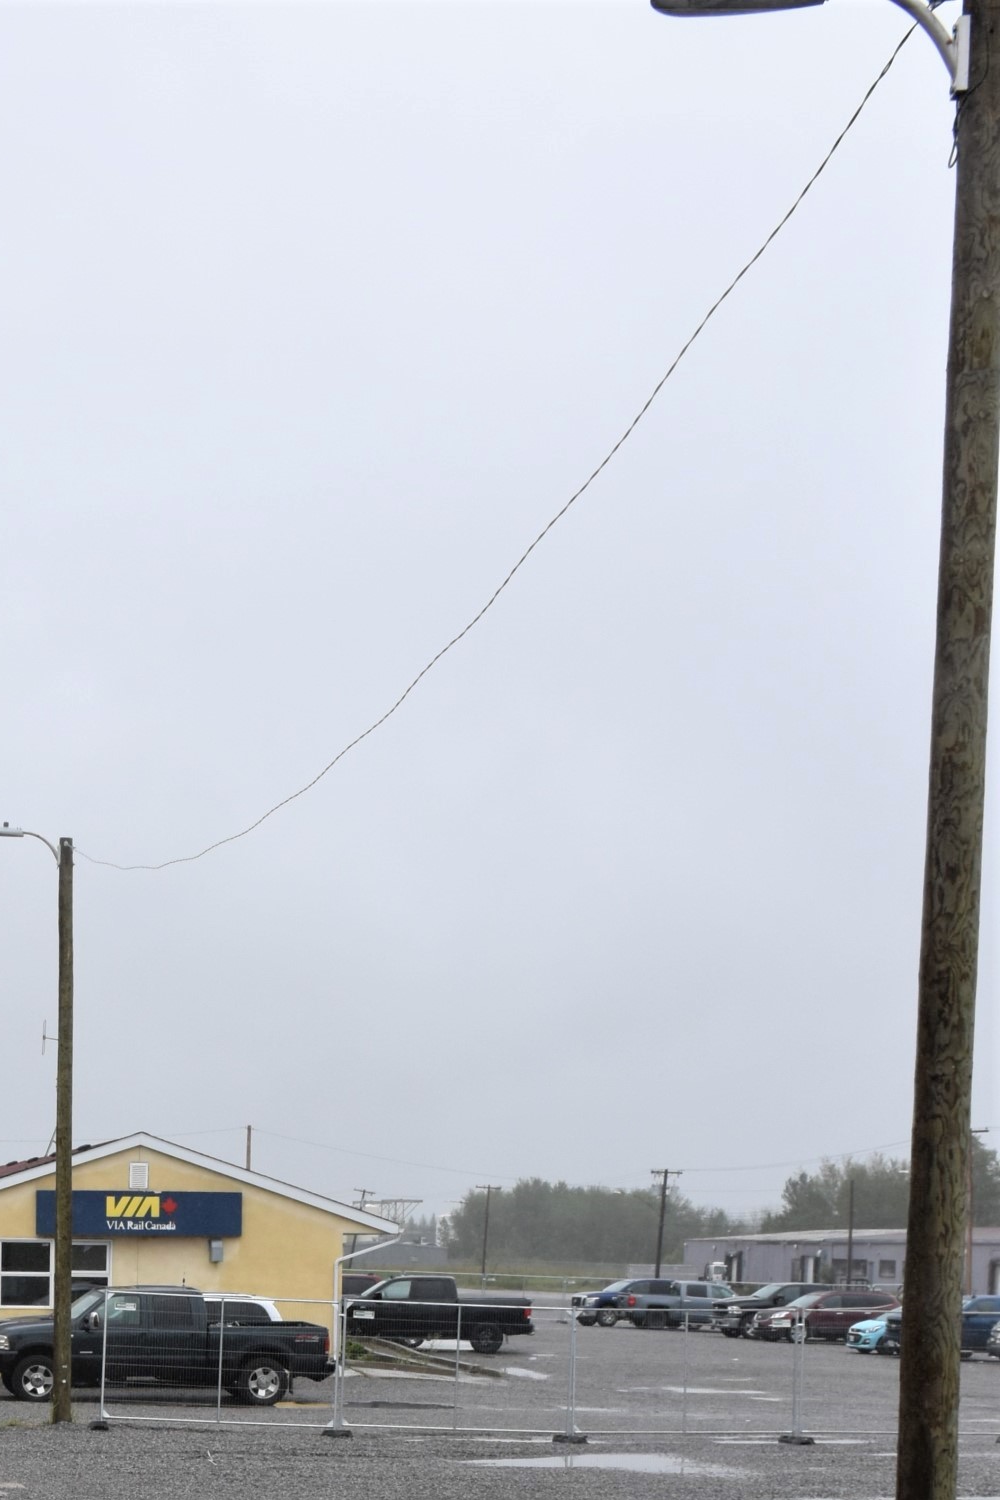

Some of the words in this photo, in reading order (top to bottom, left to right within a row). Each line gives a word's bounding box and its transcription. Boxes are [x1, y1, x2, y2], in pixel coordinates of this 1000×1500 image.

[106, 1195, 160, 1218] VIA
[106, 1220, 125, 1231] VIA
[127, 1220, 144, 1231] Rail
[145, 1220, 176, 1231] Canada
